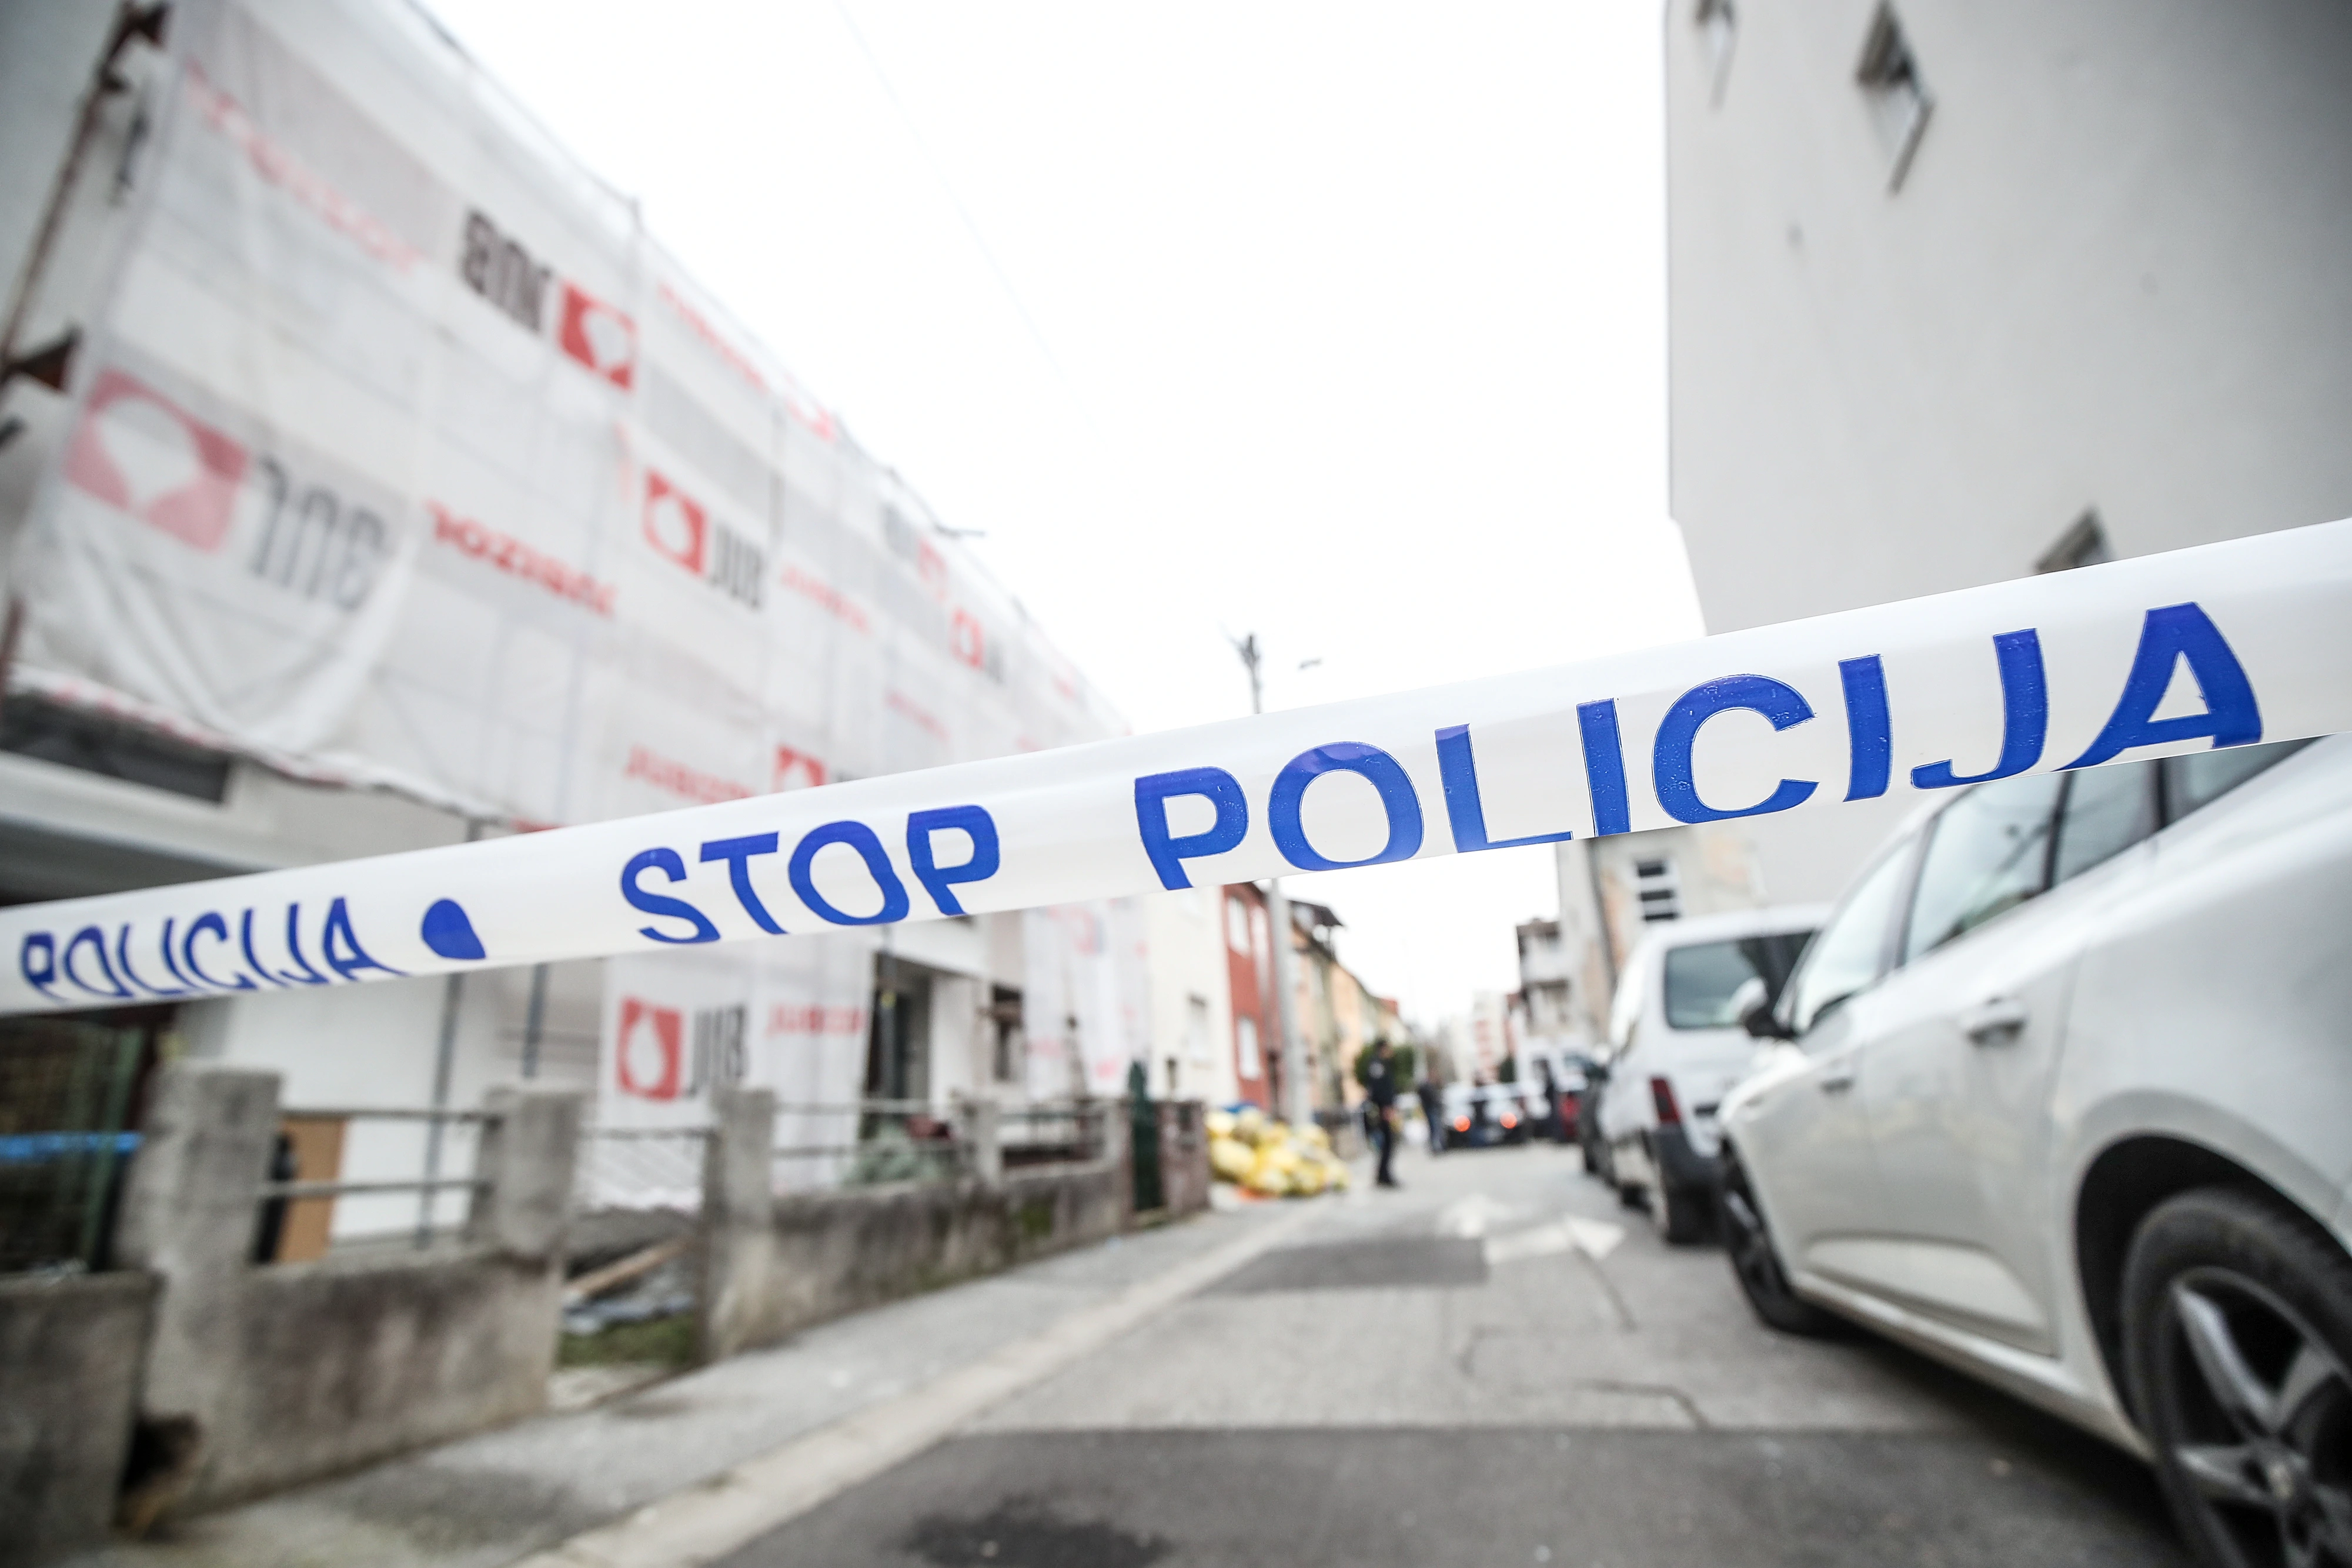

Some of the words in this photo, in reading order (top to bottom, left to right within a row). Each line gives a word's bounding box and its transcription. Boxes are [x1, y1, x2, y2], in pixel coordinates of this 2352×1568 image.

[22, 897, 406, 1002] POLICIJA
[621, 804, 1000, 944] STOP
[1135, 602, 2261, 889] POLICIJA
